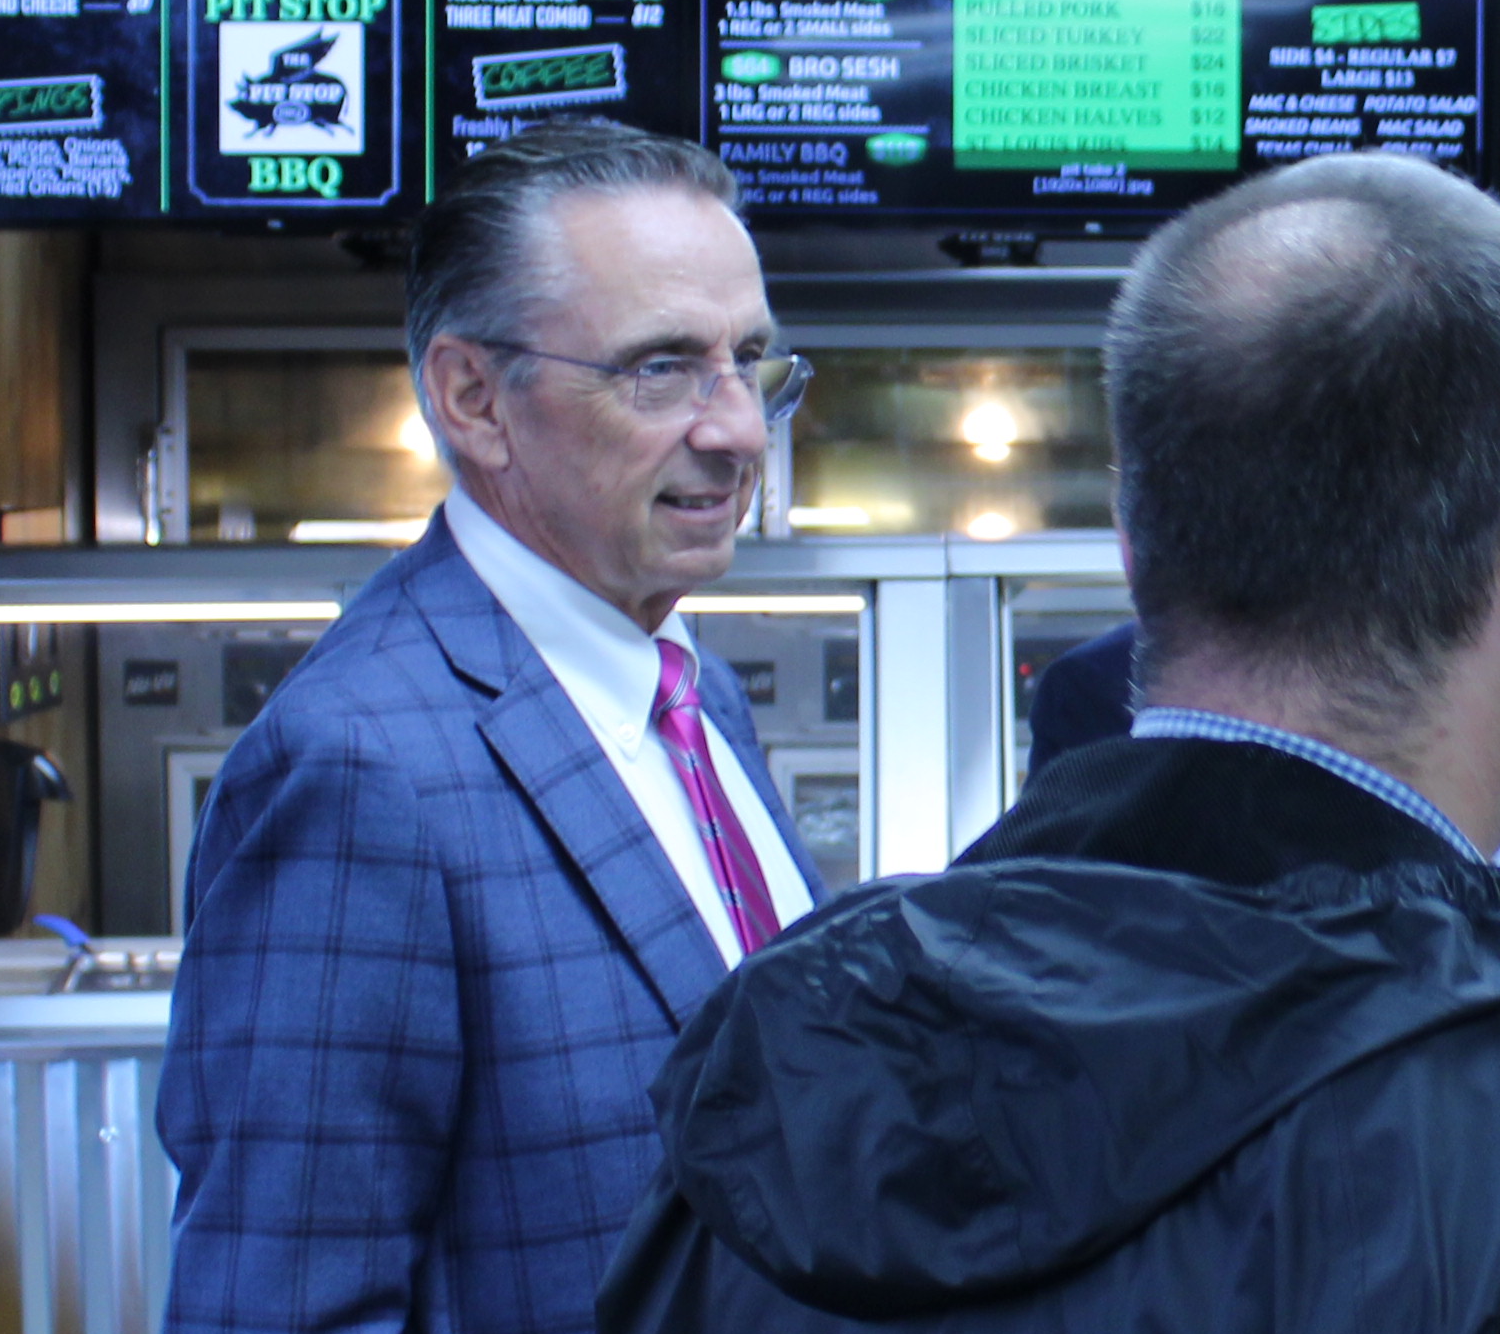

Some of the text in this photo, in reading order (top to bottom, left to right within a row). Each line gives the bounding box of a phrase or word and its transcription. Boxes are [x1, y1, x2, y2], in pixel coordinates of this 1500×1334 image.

[446, 3, 664, 29] THREE MEAT COMBO $12
[966, 0, 1052, 17] PULLED
[1059, 0, 1120, 17] PORK
[966, 27, 1225, 45] SLICED TURKEY $22
[484, 52, 610, 92] COFFEE
[789, 55, 839, 80] BRO
[841, 56, 900, 80] SESH
[966, 53, 1224, 72] SLICED BRISKET $24
[249, 84, 343, 104] PIT STOP
[965, 80, 1065, 99] CHICKEN
[1074, 80, 1163, 99] BREAST
[965, 108, 1224, 126] CHICKEN HALVES $12
[719, 142, 797, 162] FAMILY
[800, 142, 848, 166] BBQ
[249, 157, 342, 199] BBQ
